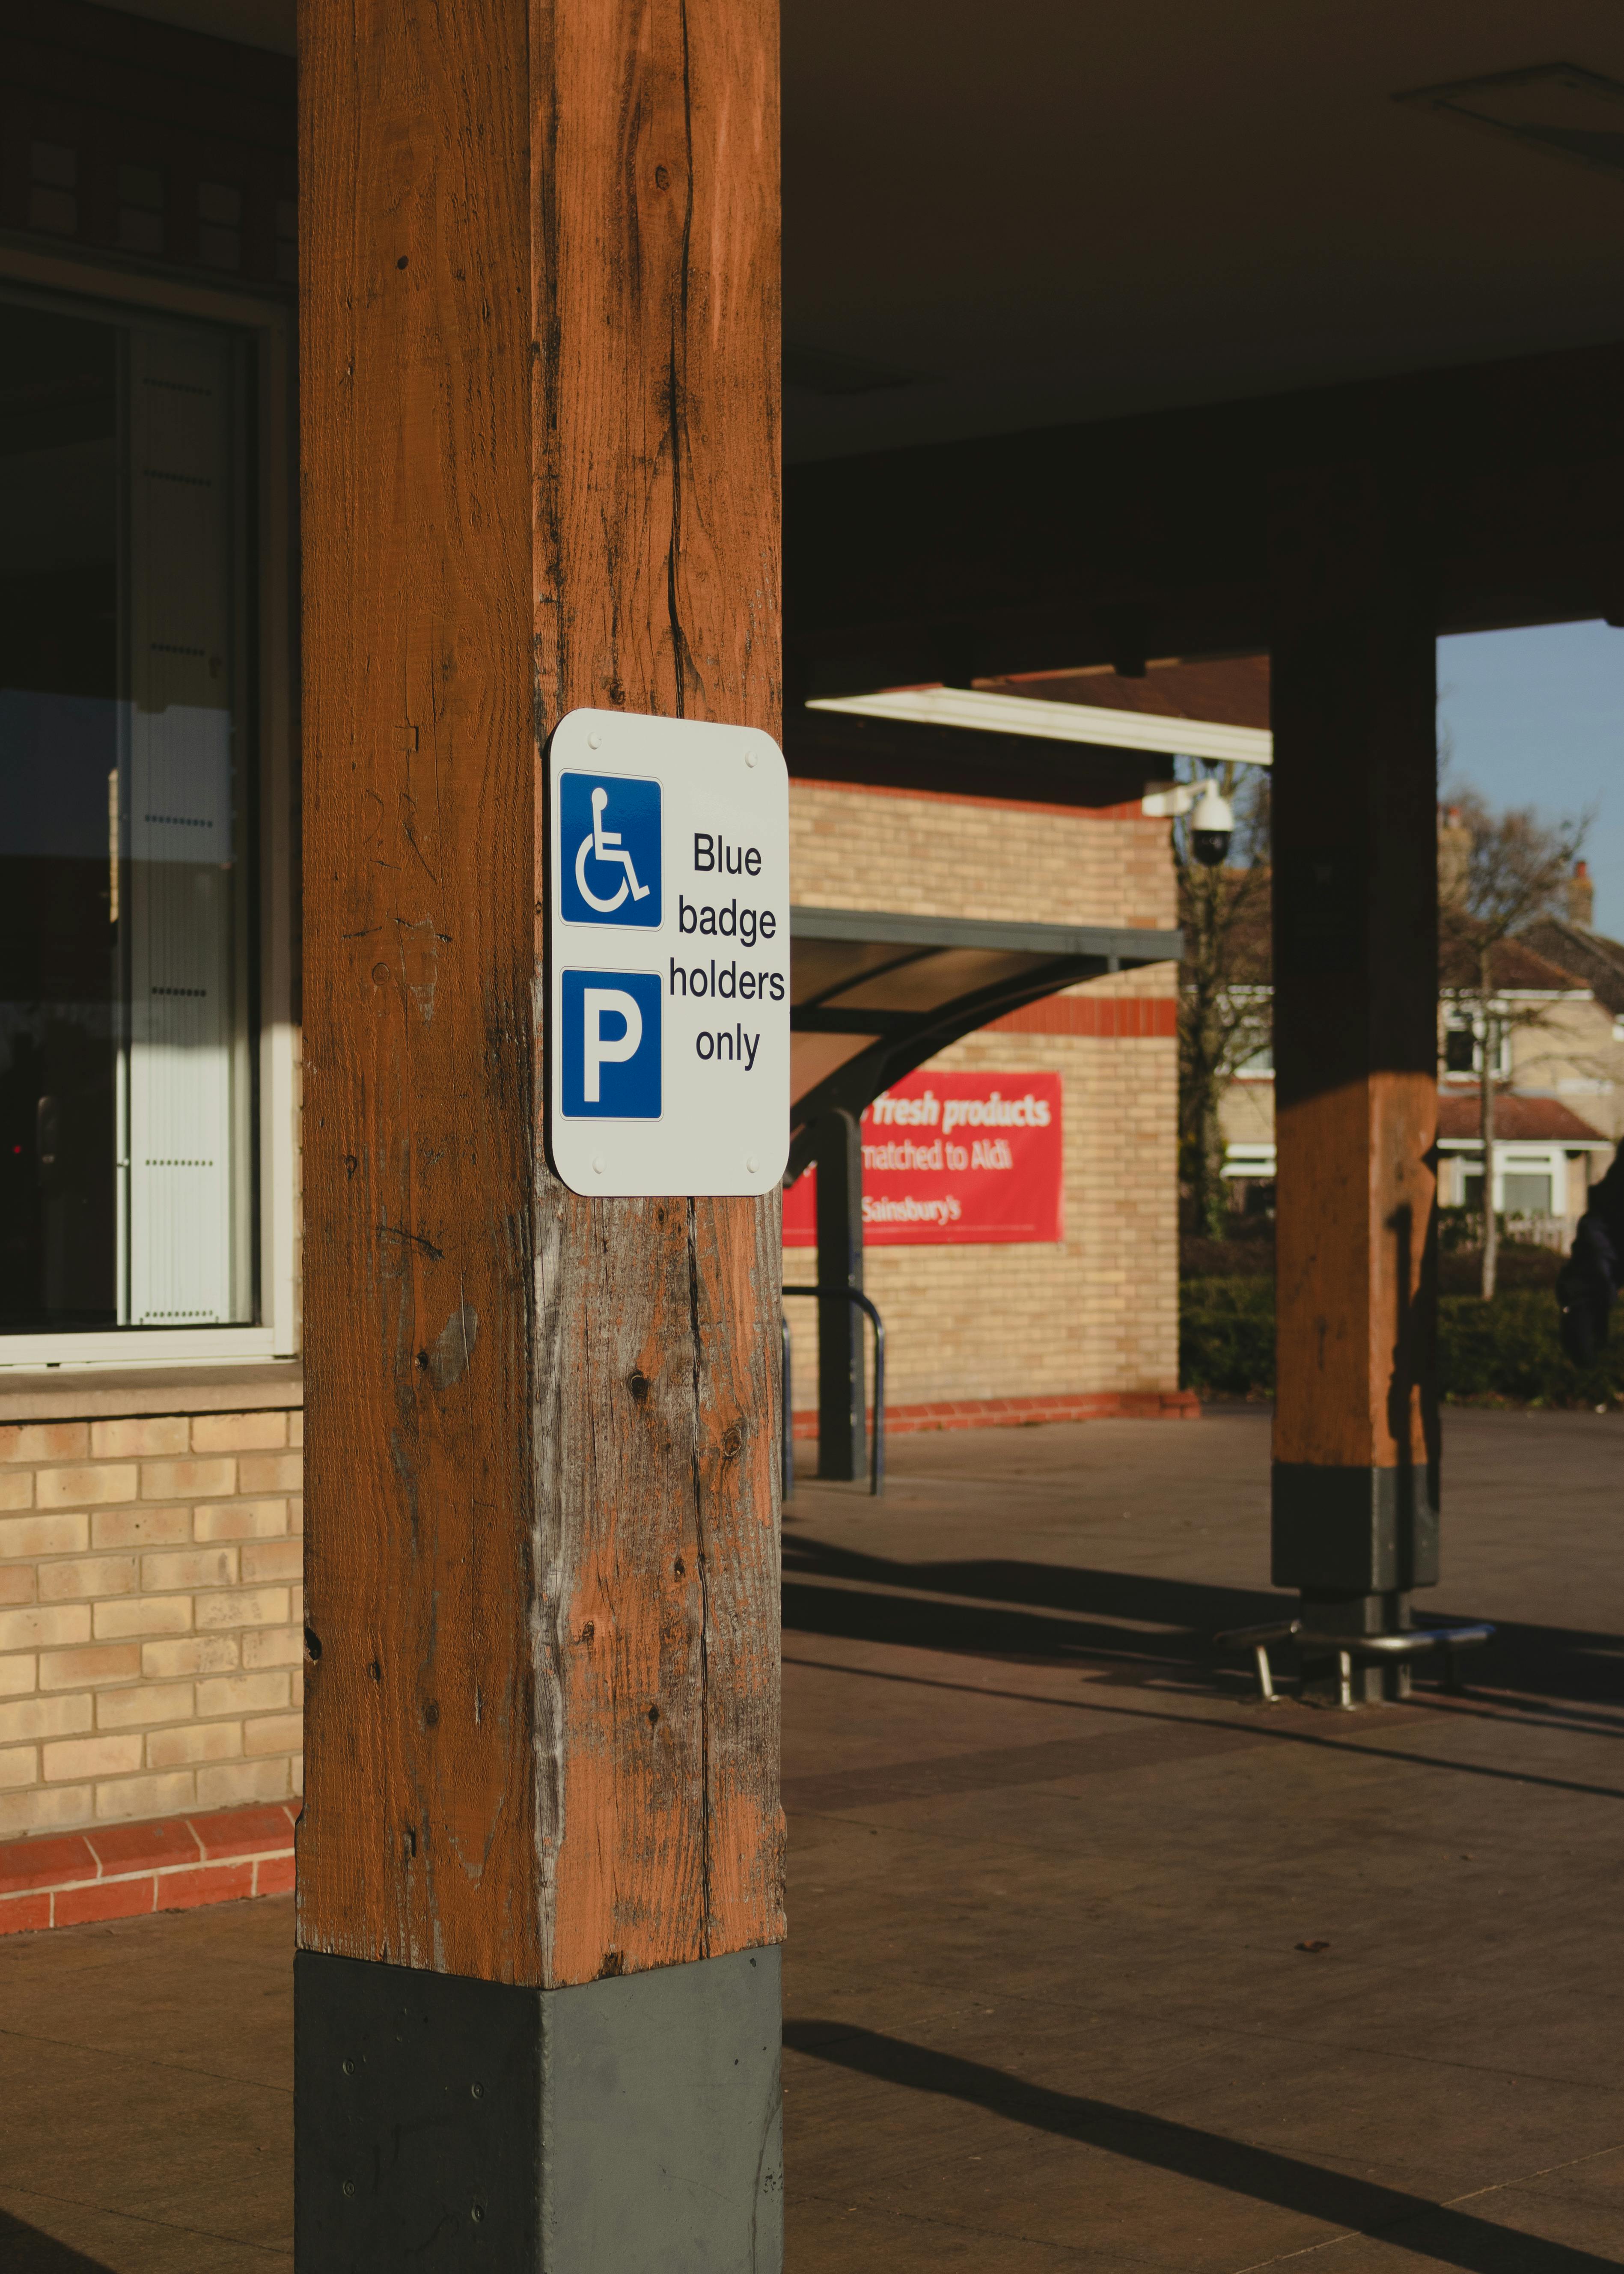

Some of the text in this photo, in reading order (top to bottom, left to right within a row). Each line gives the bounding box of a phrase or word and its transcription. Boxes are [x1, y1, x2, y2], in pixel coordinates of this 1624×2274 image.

[694, 833, 761, 876] Blue
[679, 895, 776, 947] badge
[670, 957, 785, 1001] holders
[584, 988, 642, 1102] P
[696, 1023, 760, 1071] only
[873, 1090, 1051, 1135] fresh products
[945, 1142, 969, 1170] to
[971, 1139, 1012, 1170] Aldi
[862, 1195, 961, 1225] Sainsbury's
